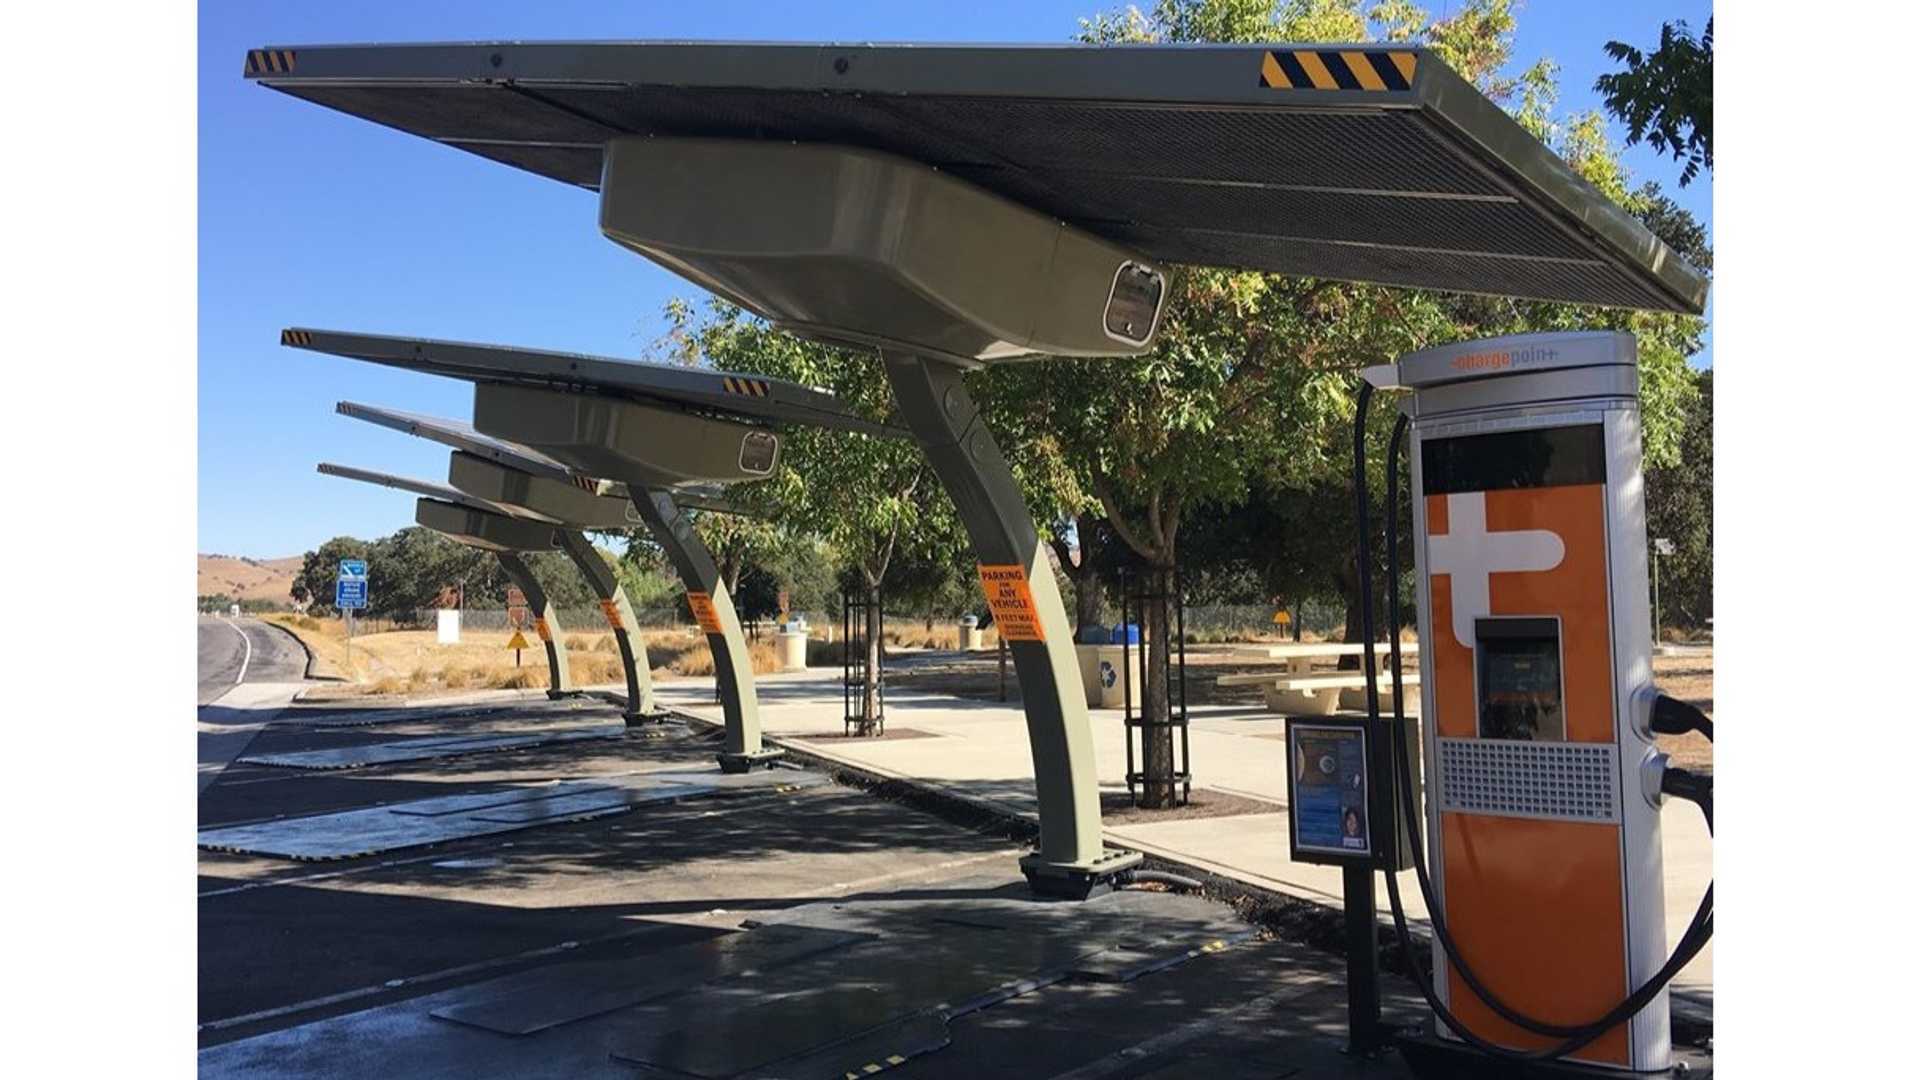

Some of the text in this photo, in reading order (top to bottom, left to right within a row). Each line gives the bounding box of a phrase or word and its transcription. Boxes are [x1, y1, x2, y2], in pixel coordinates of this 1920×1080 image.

[982, 571, 1023, 580] PARKING
[999, 589, 1016, 597] ANY
[991, 599, 1028, 609] VEHICLE
